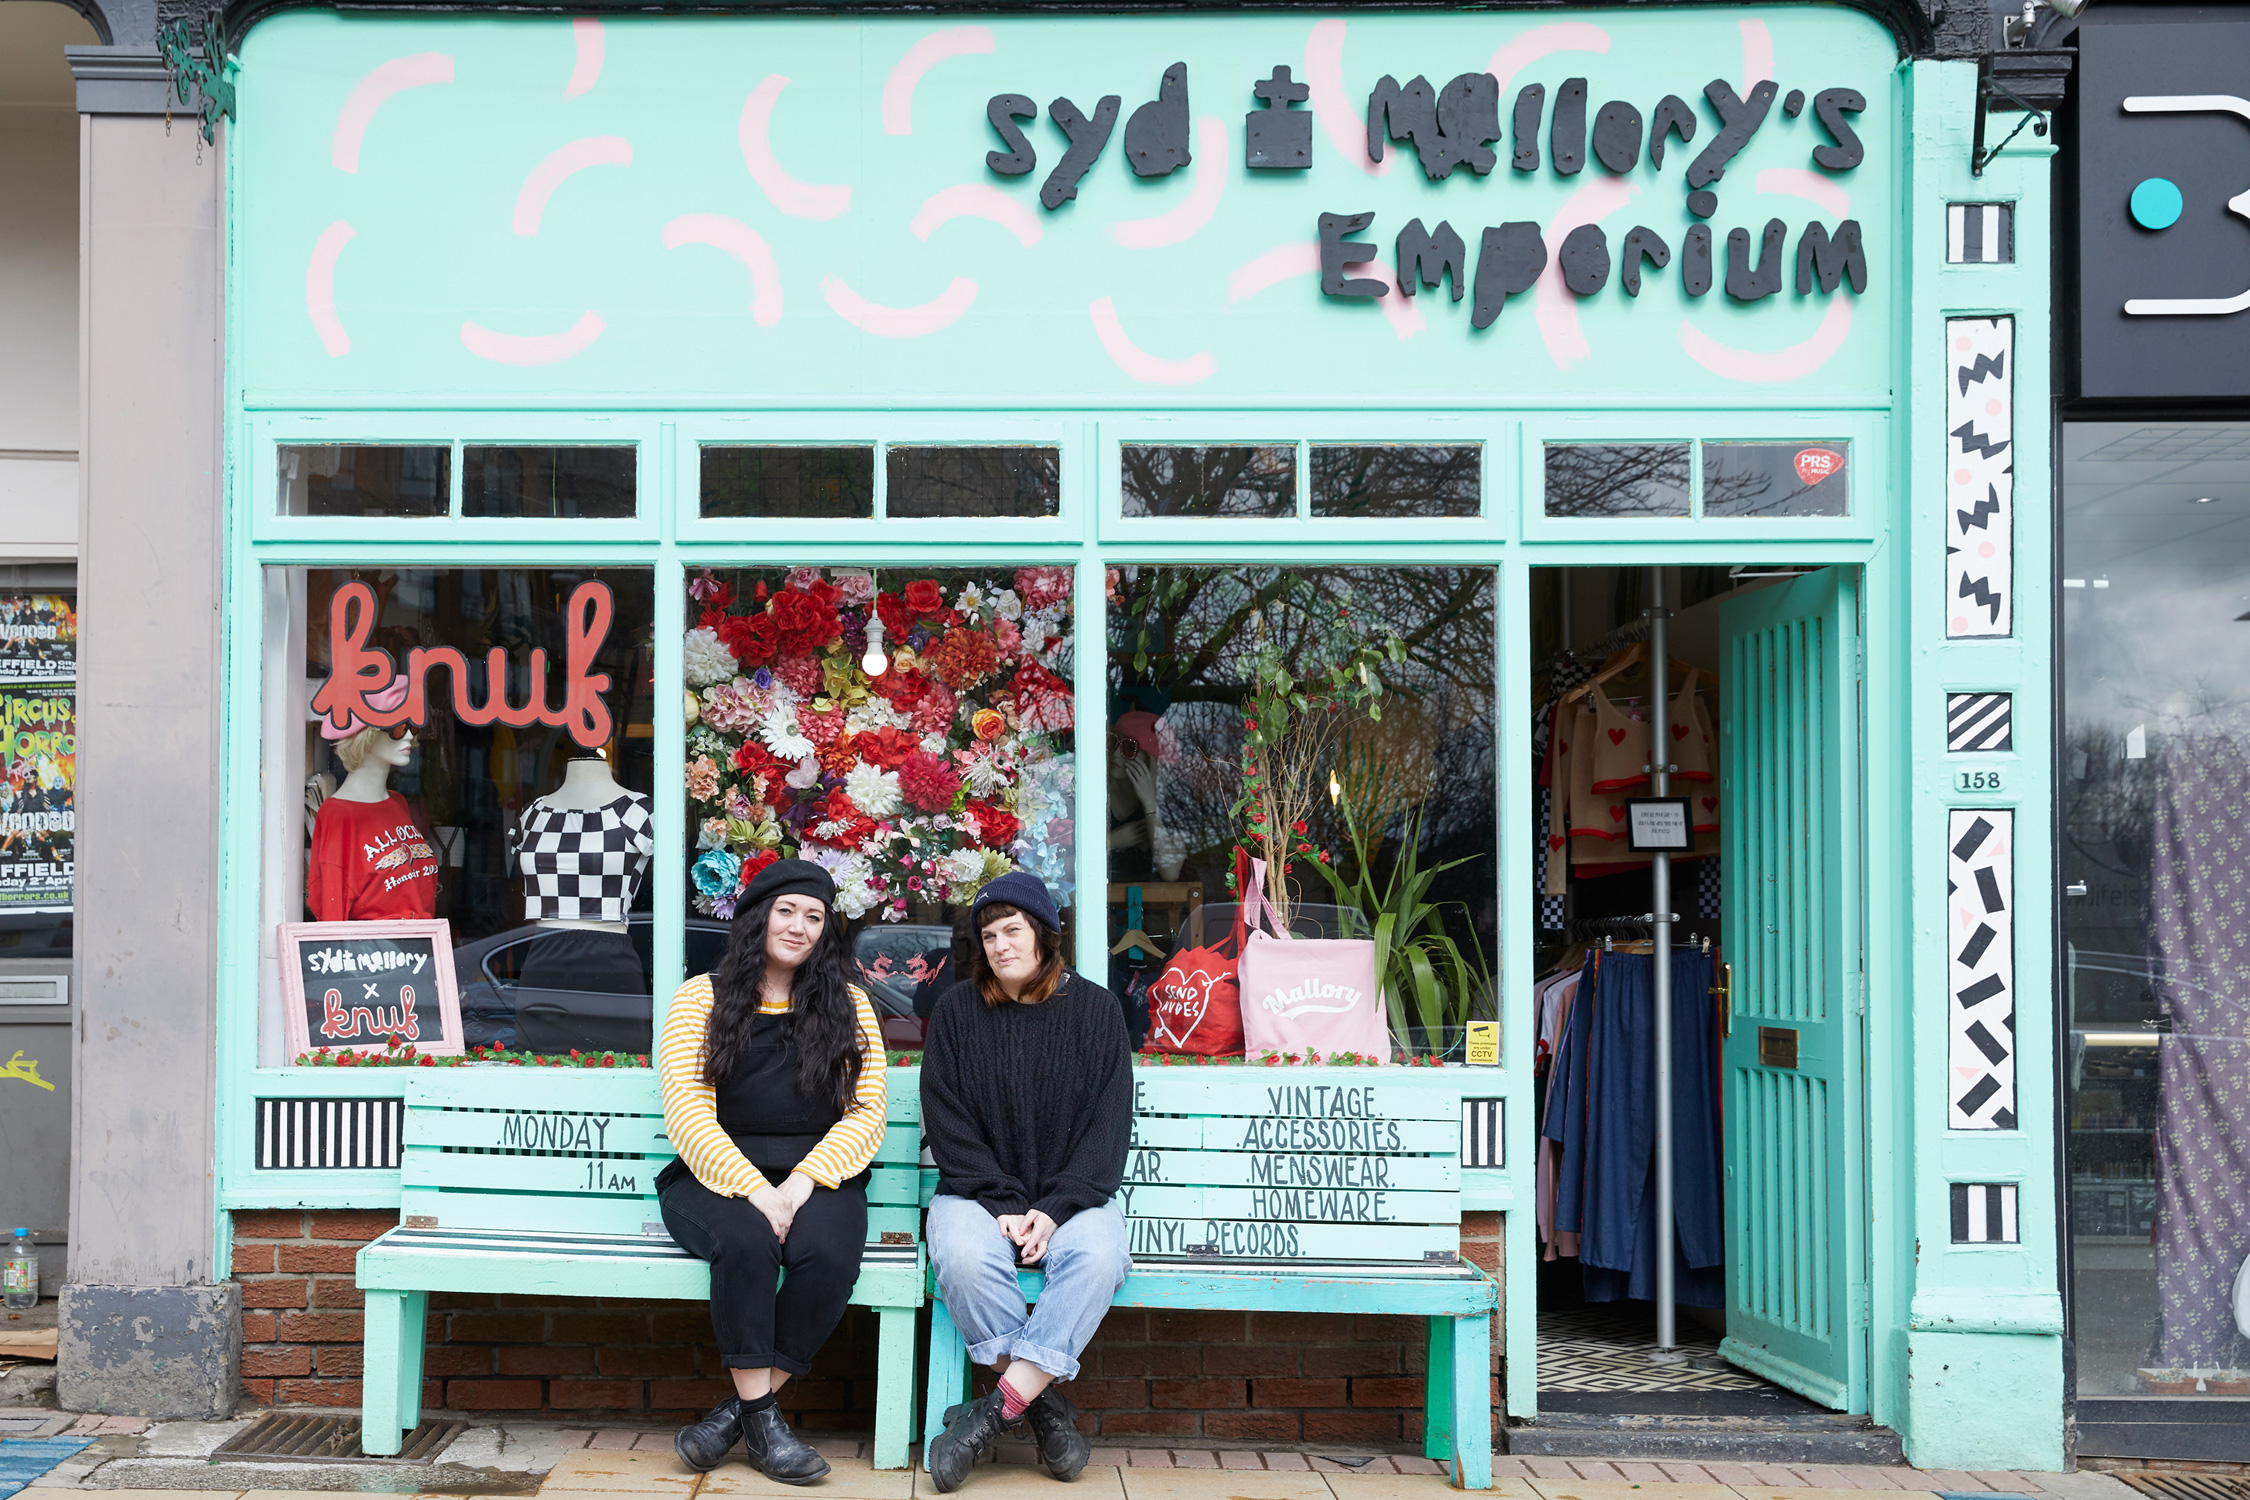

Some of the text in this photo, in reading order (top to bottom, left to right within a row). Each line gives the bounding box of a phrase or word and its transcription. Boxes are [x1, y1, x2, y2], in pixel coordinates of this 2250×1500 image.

[985, 61, 1194, 210] syd
[1801, 454, 1831, 468] PRS
[0, 659, 57, 670] FFIELD
[310, 579, 615, 748] knuf
[1961, 771, 2000, 789] 158
[1165, 984, 1198, 1000] SEND
[1262, 977, 1362, 1015] Mallory
[320, 985, 420, 1040] knuf
[1161, 1001, 1200, 1017] NUDES
[1471, 1050, 1493, 1058] CCTV
